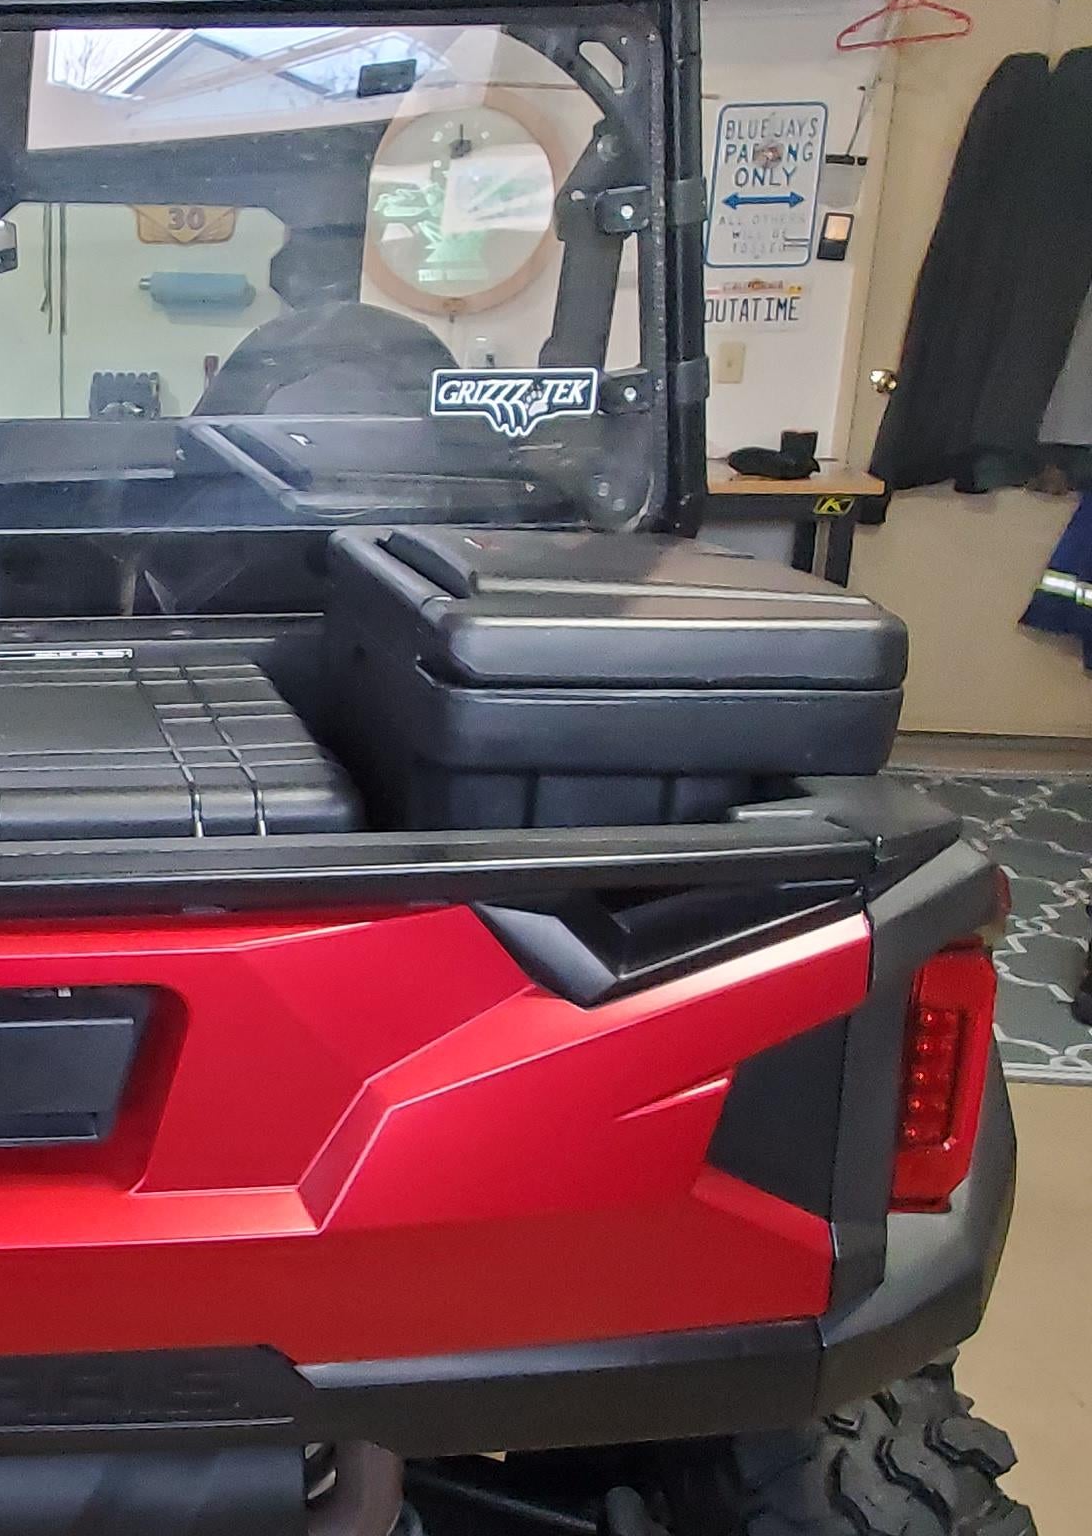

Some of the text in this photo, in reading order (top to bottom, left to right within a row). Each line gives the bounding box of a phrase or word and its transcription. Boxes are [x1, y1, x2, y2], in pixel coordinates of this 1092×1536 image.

[725, 117, 819, 140] BLUE JAYS
[724, 141, 814, 164] PANG
[734, 166, 797, 188] ONLY
[168, 207, 205, 231] 30
[541, 378, 591, 405] TEK
